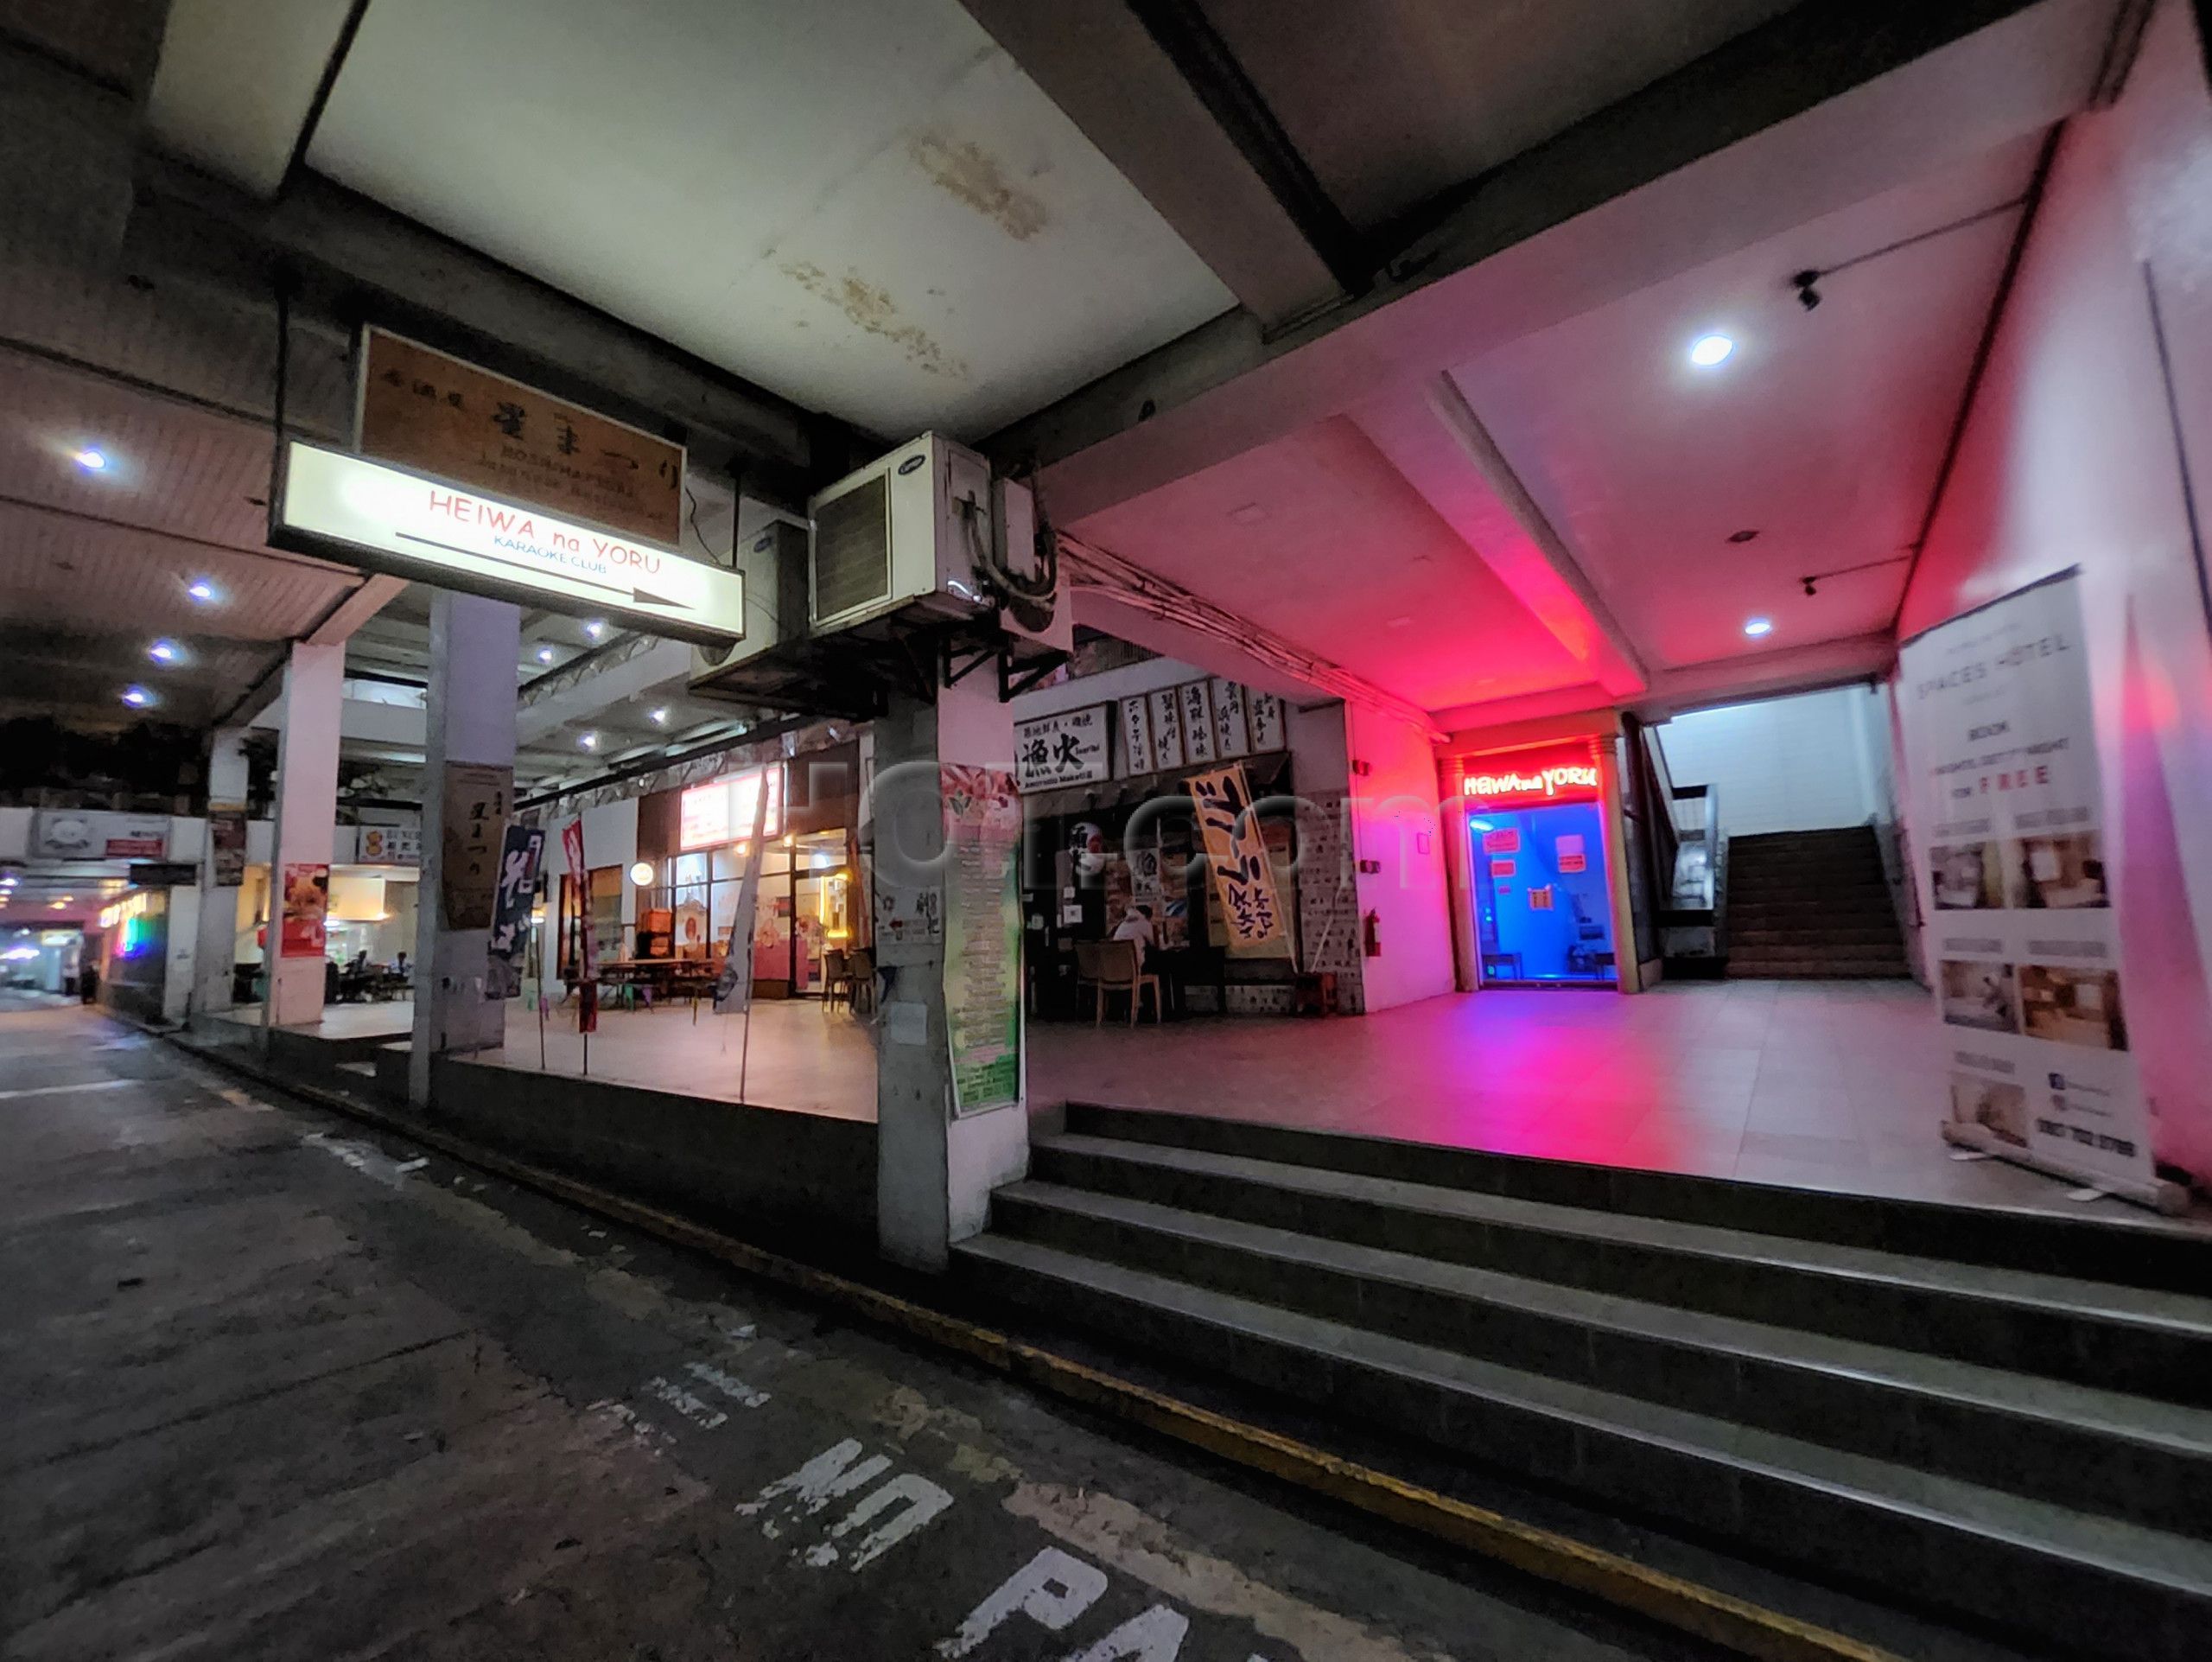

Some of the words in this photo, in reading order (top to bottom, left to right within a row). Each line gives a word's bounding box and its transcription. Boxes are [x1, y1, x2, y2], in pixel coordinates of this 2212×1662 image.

[429, 489, 535, 539] HEIWA
[552, 532, 581, 554] na
[592, 538, 663, 576] YORU
[493, 535, 567, 564] KARAOKE
[570, 555, 607, 576] CLUB
[1021, 732, 1084, 778] 漁火
[1980, 765, 2050, 794] FREE
